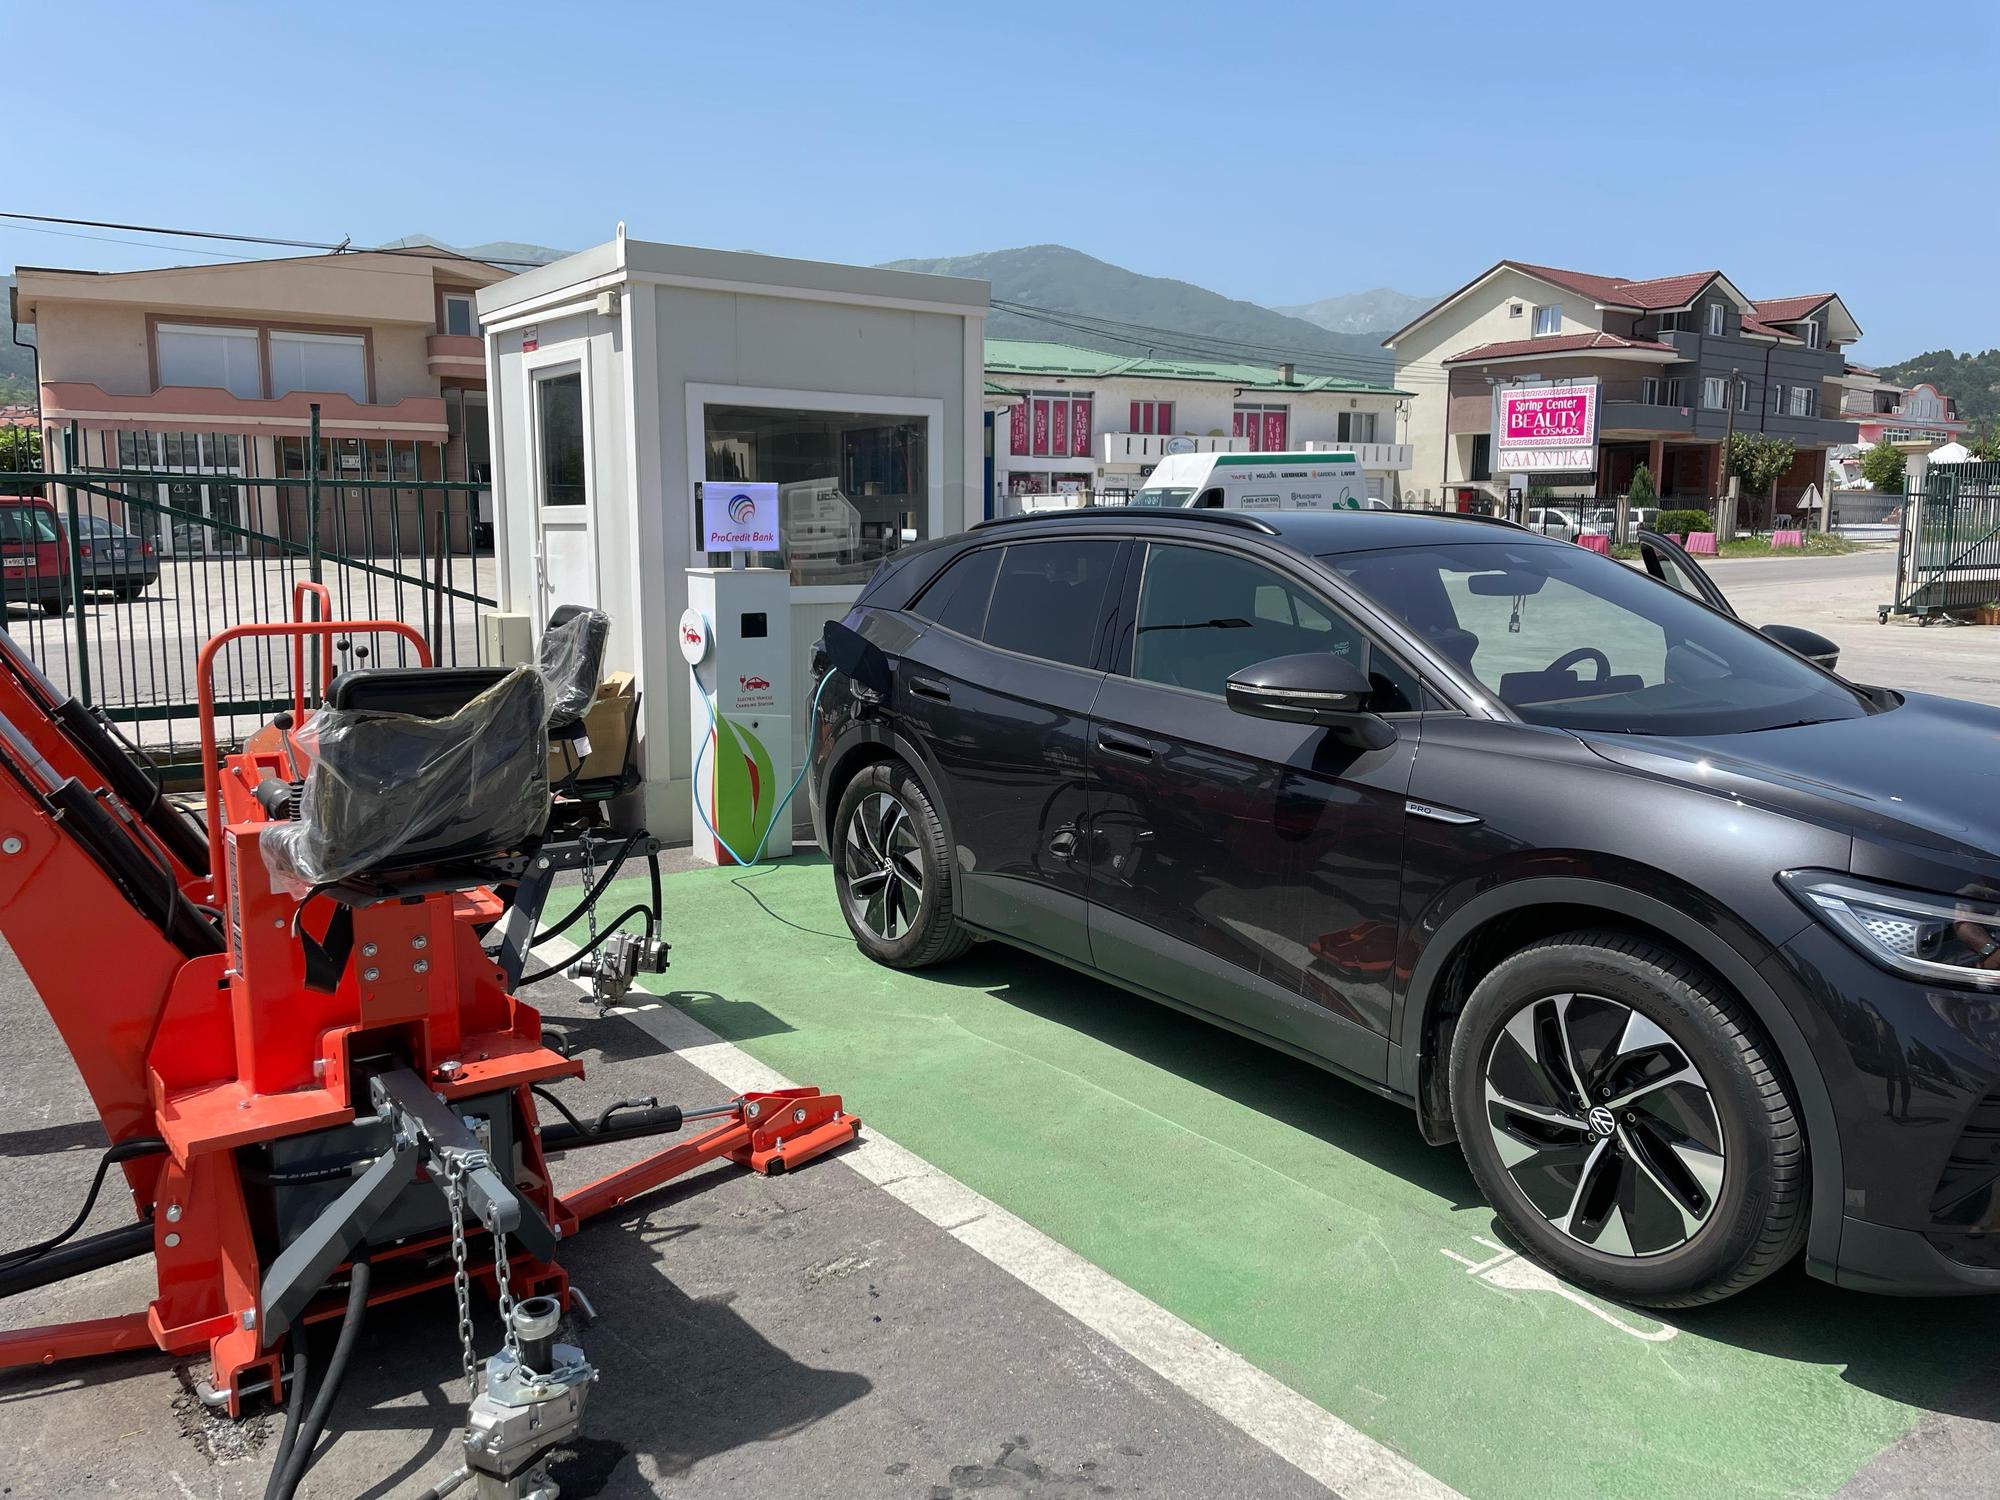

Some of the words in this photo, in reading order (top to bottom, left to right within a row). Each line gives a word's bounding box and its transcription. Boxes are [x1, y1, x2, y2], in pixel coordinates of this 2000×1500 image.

[1515, 401, 1543, 412] Spring
[1546, 399, 1577, 410] Center
[1511, 410, 1581, 429] BEAUTY
[1533, 426, 1579, 436] COSMOS
[711, 532, 751, 542] ProCredit
[752, 532, 774, 542] Bank
[1410, 804, 1432, 814] PRO
